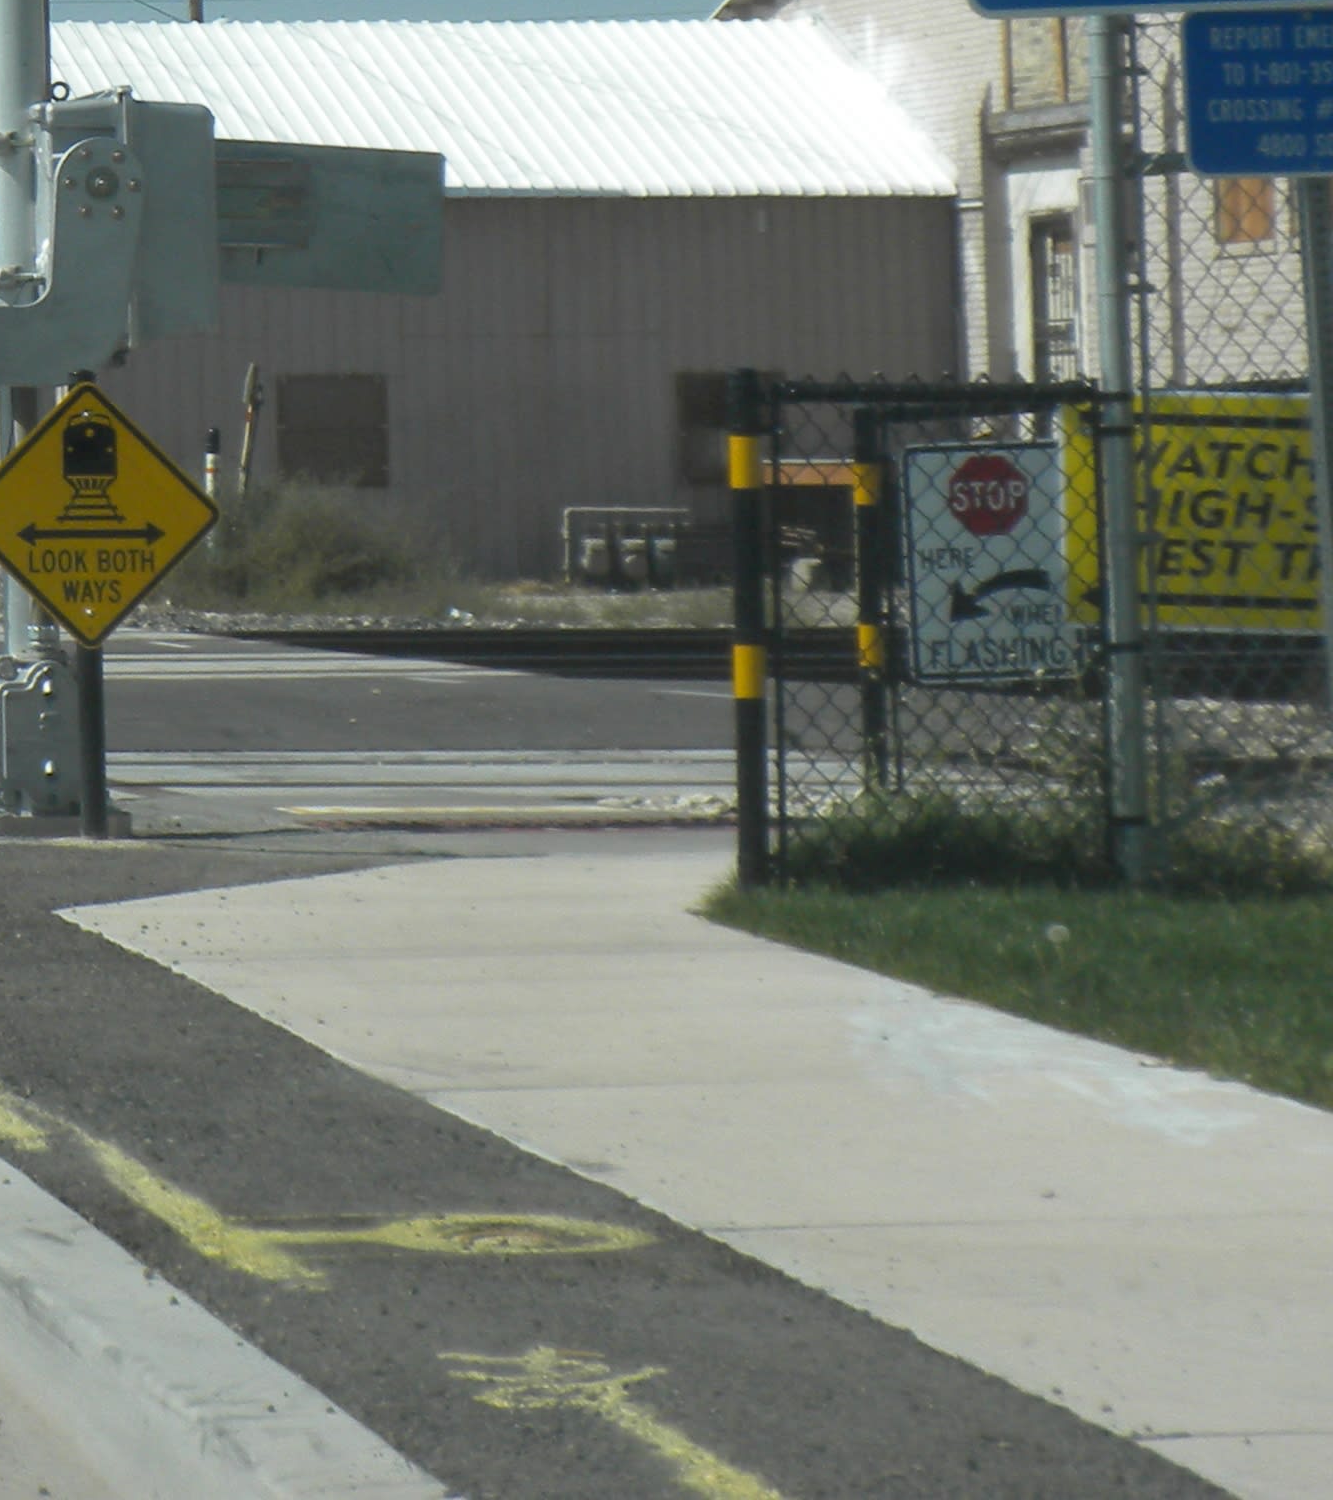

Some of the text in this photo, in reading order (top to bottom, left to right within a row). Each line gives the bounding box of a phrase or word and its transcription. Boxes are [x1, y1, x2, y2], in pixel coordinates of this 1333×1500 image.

[1209, 26, 1282, 50] REPORT
[1222, 62, 1245, 86] TO
[1207, 97, 1303, 122] CROSSING
[952, 480, 1025, 512] STOP
[28, 550, 155, 573] LOOK BOTH
[919, 548, 974, 569] HERE
[62, 580, 122, 603] WAYS
[931, 638, 1068, 670] FLASHING
